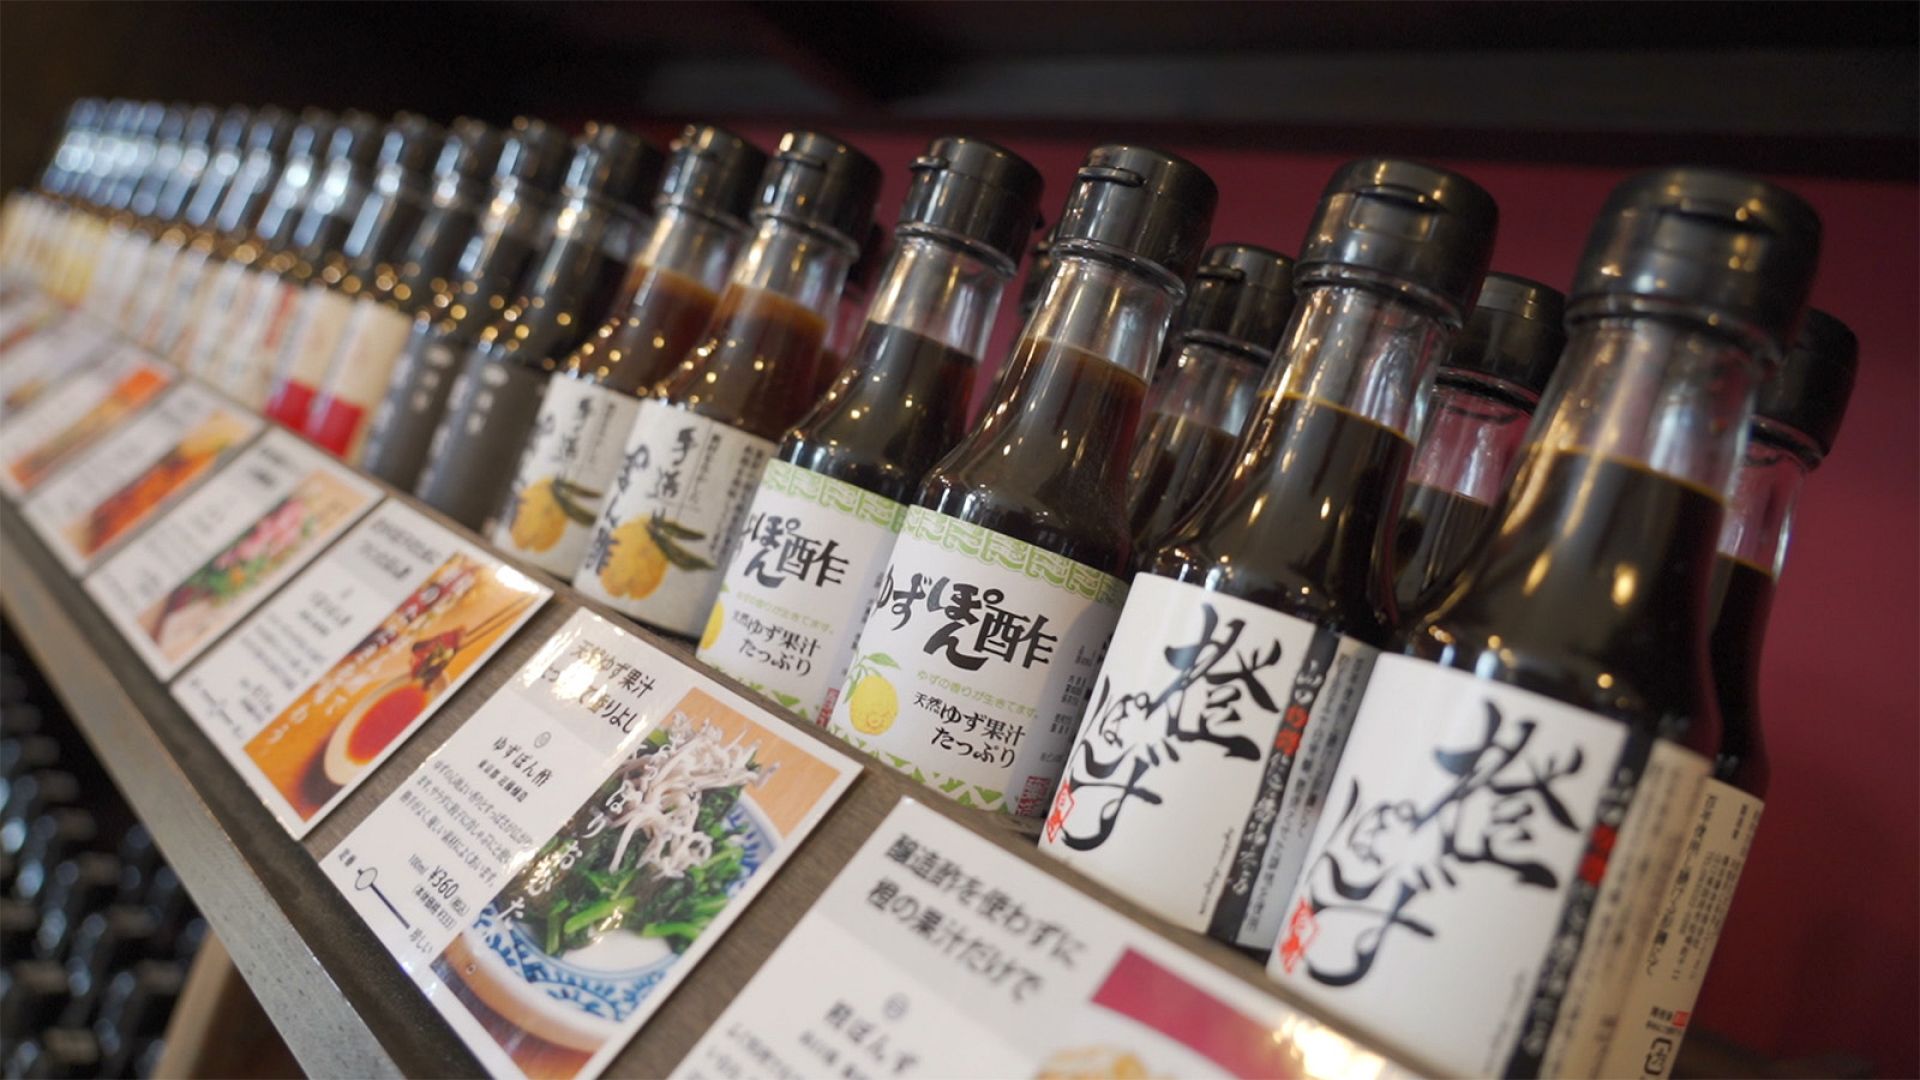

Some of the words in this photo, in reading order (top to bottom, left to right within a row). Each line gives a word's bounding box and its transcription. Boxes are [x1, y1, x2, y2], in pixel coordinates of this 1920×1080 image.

[913, 691, 1027, 747] 天然ゆず果汁
[930, 726, 1016, 769] たっぷり
